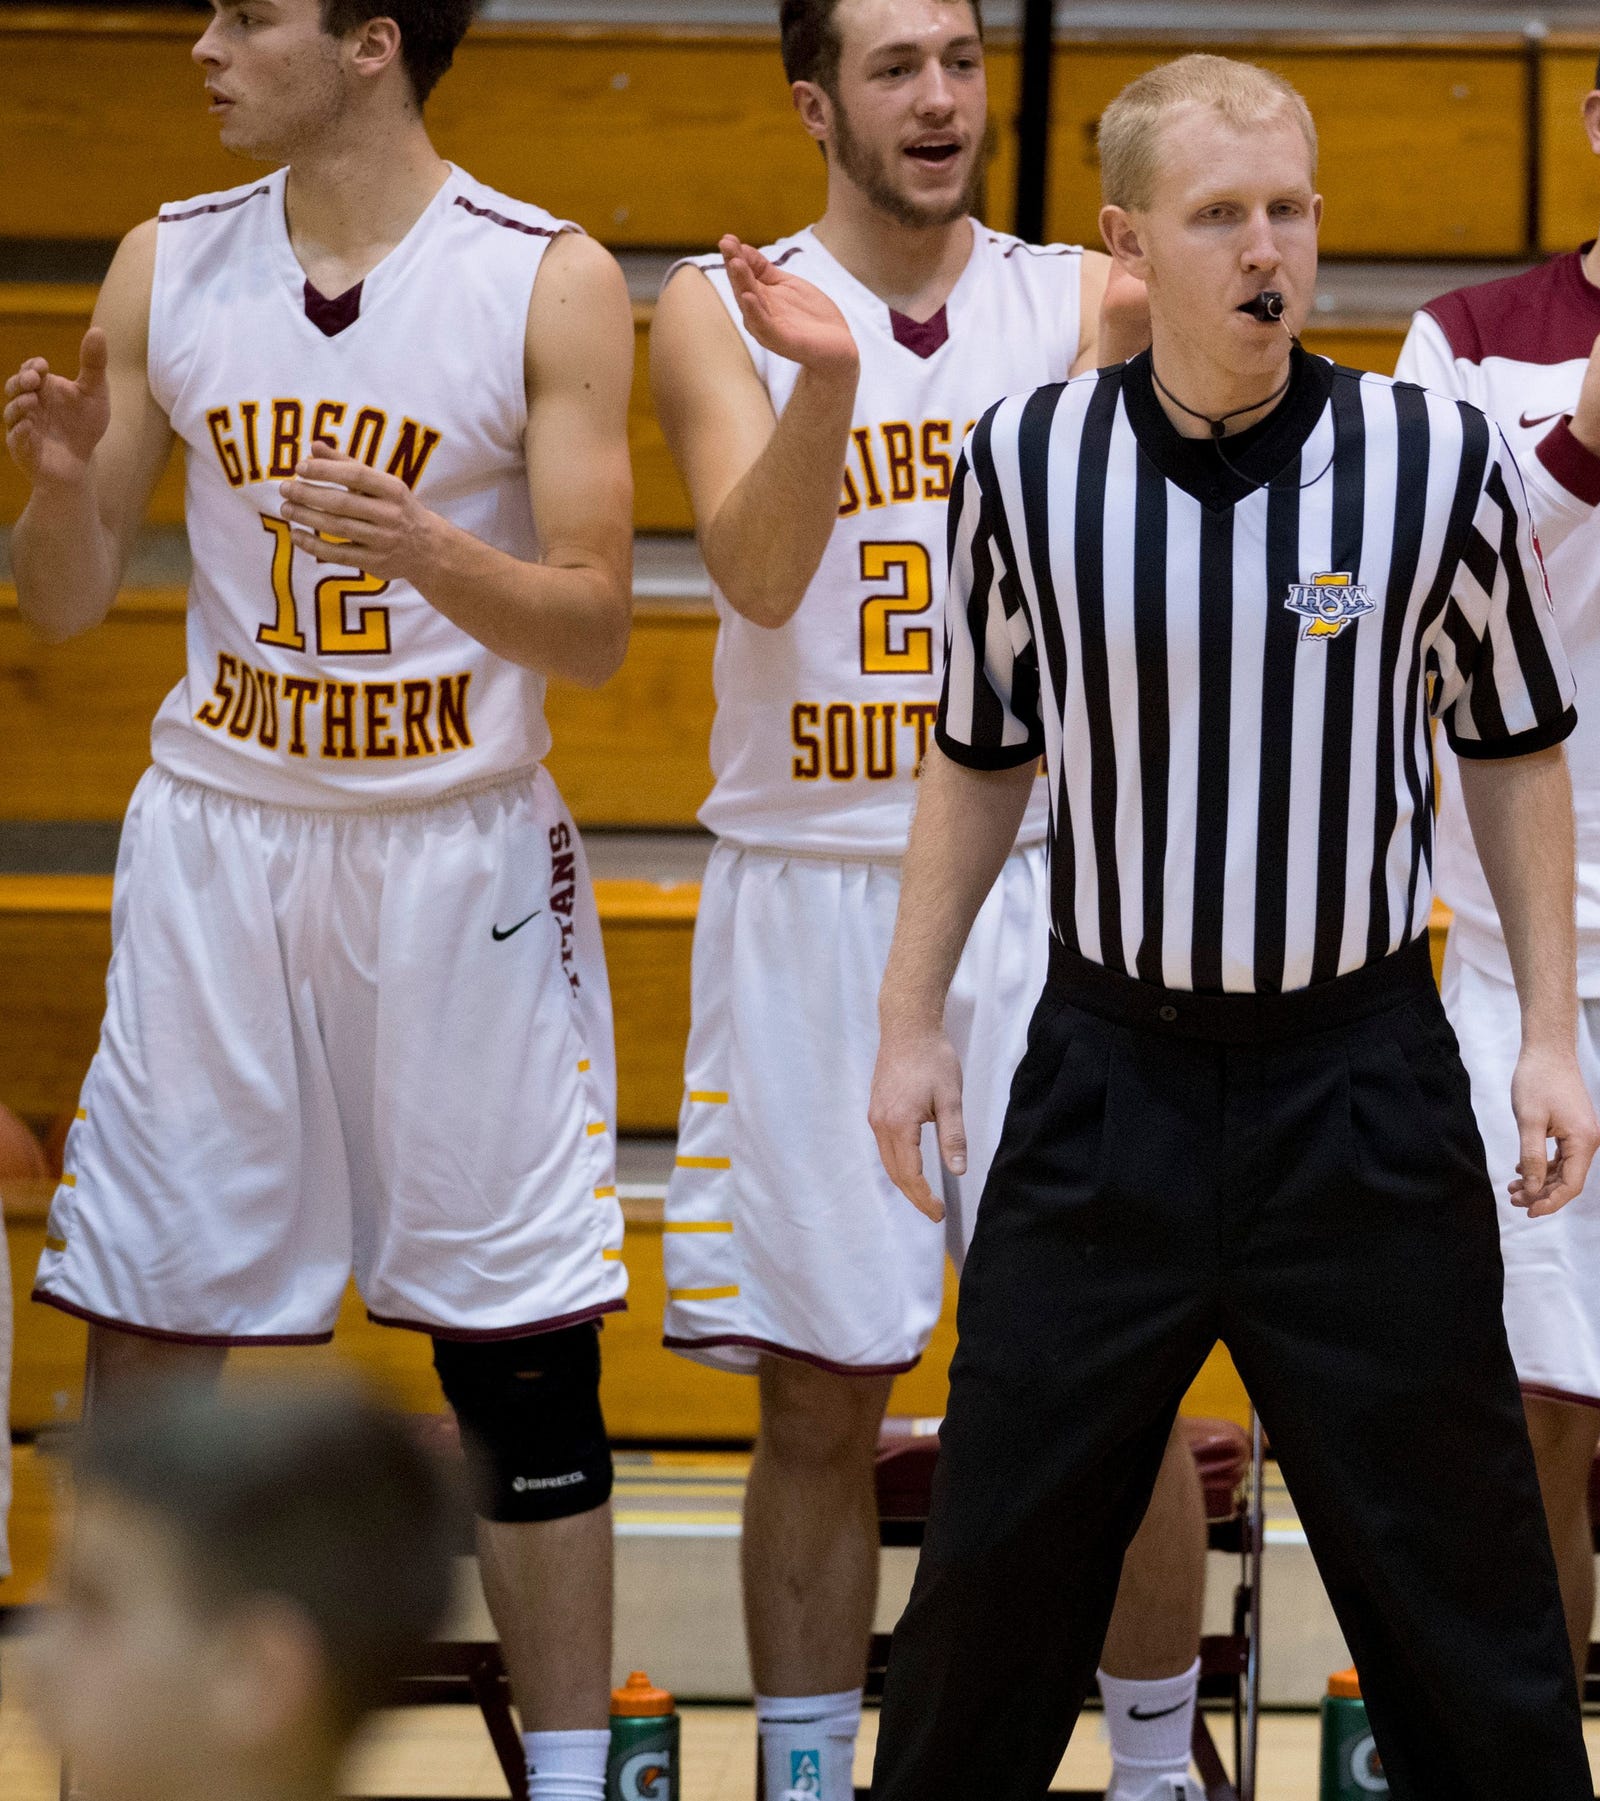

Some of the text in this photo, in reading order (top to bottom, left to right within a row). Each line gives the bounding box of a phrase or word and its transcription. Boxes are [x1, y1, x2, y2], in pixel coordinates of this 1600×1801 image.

[256, 511, 392, 657] 12
[1289, 586, 1371, 618] IHSAA
[195, 651, 473, 759] SOUTHERN
